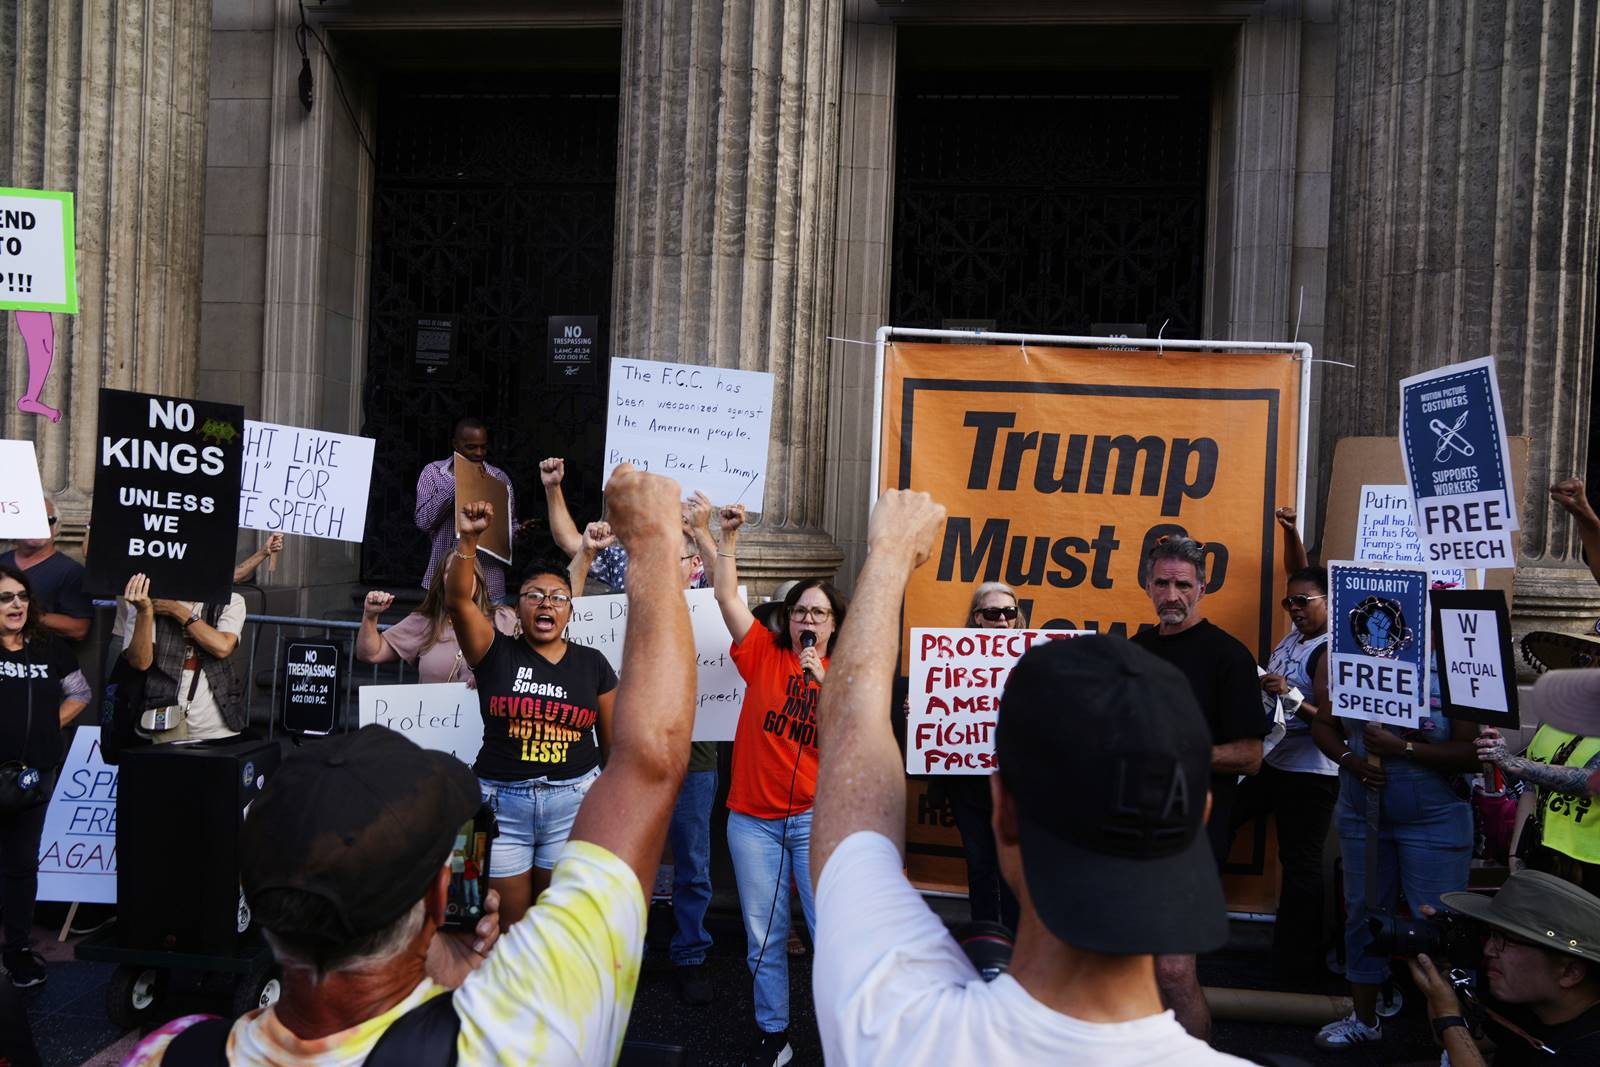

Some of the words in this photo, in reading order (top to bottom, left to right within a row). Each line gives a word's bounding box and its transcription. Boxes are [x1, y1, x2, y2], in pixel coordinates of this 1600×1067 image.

[564, 325, 582, 338] NO
[621, 365, 651, 383] The
[662, 368, 702, 389] F.C.C.
[717, 374, 741, 394] has
[616, 390, 645, 407] been
[657, 399, 718, 414] weaponized
[727, 405, 764, 419] against
[1421, 389, 1442, 402] MOTION
[1442, 385, 1466, 398] PICTURE
[1422, 394, 1468, 413] COSTUMERS
[149, 398, 195, 432] NO
[648, 418, 700, 435] American
[707, 427, 751, 440] people.
[243, 427, 279, 459] HT
[102, 436, 225, 476] KINGS
[962, 410, 1218, 516] Trump
[609, 448, 649, 471] Bring
[665, 452, 711, 473] Back
[723, 458, 758, 495] Jimmy
[1431, 466, 1478, 484] SUPPORTS
[284, 465, 330, 502] FOR
[119, 487, 215, 514] UNLESS
[143, 513, 179, 533] WE
[240, 496, 258, 528] E
[266, 497, 345, 538] SPEECH
[1372, 514, 1389, 530] pull
[1392, 515, 1405, 526] his
[1424, 501, 1503, 535] FREE
[1382, 527, 1397, 537] his
[128, 538, 187, 560] BOW
[936, 516, 1119, 589] Must
[1368, 551, 1393, 560] make
[1396, 550, 1412, 561] him
[1406, 542, 1420, 554] my
[1429, 539, 1505, 561] SPEECH
[1345, 576, 1409, 594] SOLIDARITY
[1457, 613, 1478, 634] W
[305, 650, 317, 663] NO
[921, 632, 1038, 661] PROTECT
[1464, 637, 1476, 658] T
[288, 662, 336, 678] TRESPASSING
[516, 666, 533, 680] BA
[1338, 661, 1413, 696] FREE
[1451, 660, 1497, 677] ACTUAL
[292, 683, 308, 692] LAMC
[512, 679, 568, 699] Speaks:
[695, 688, 741, 707] peech
[1470, 678, 1480, 698] F
[291, 695, 303, 703] 602
[315, 696, 327, 704] P.C.
[1338, 693, 1412, 719] SPEECH
[375, 699, 463, 730] Protect
[489, 695, 598, 729] REVOLUTION
[521, 740, 569, 763] LESS!
[38, 841, 117, 871] AGAI
